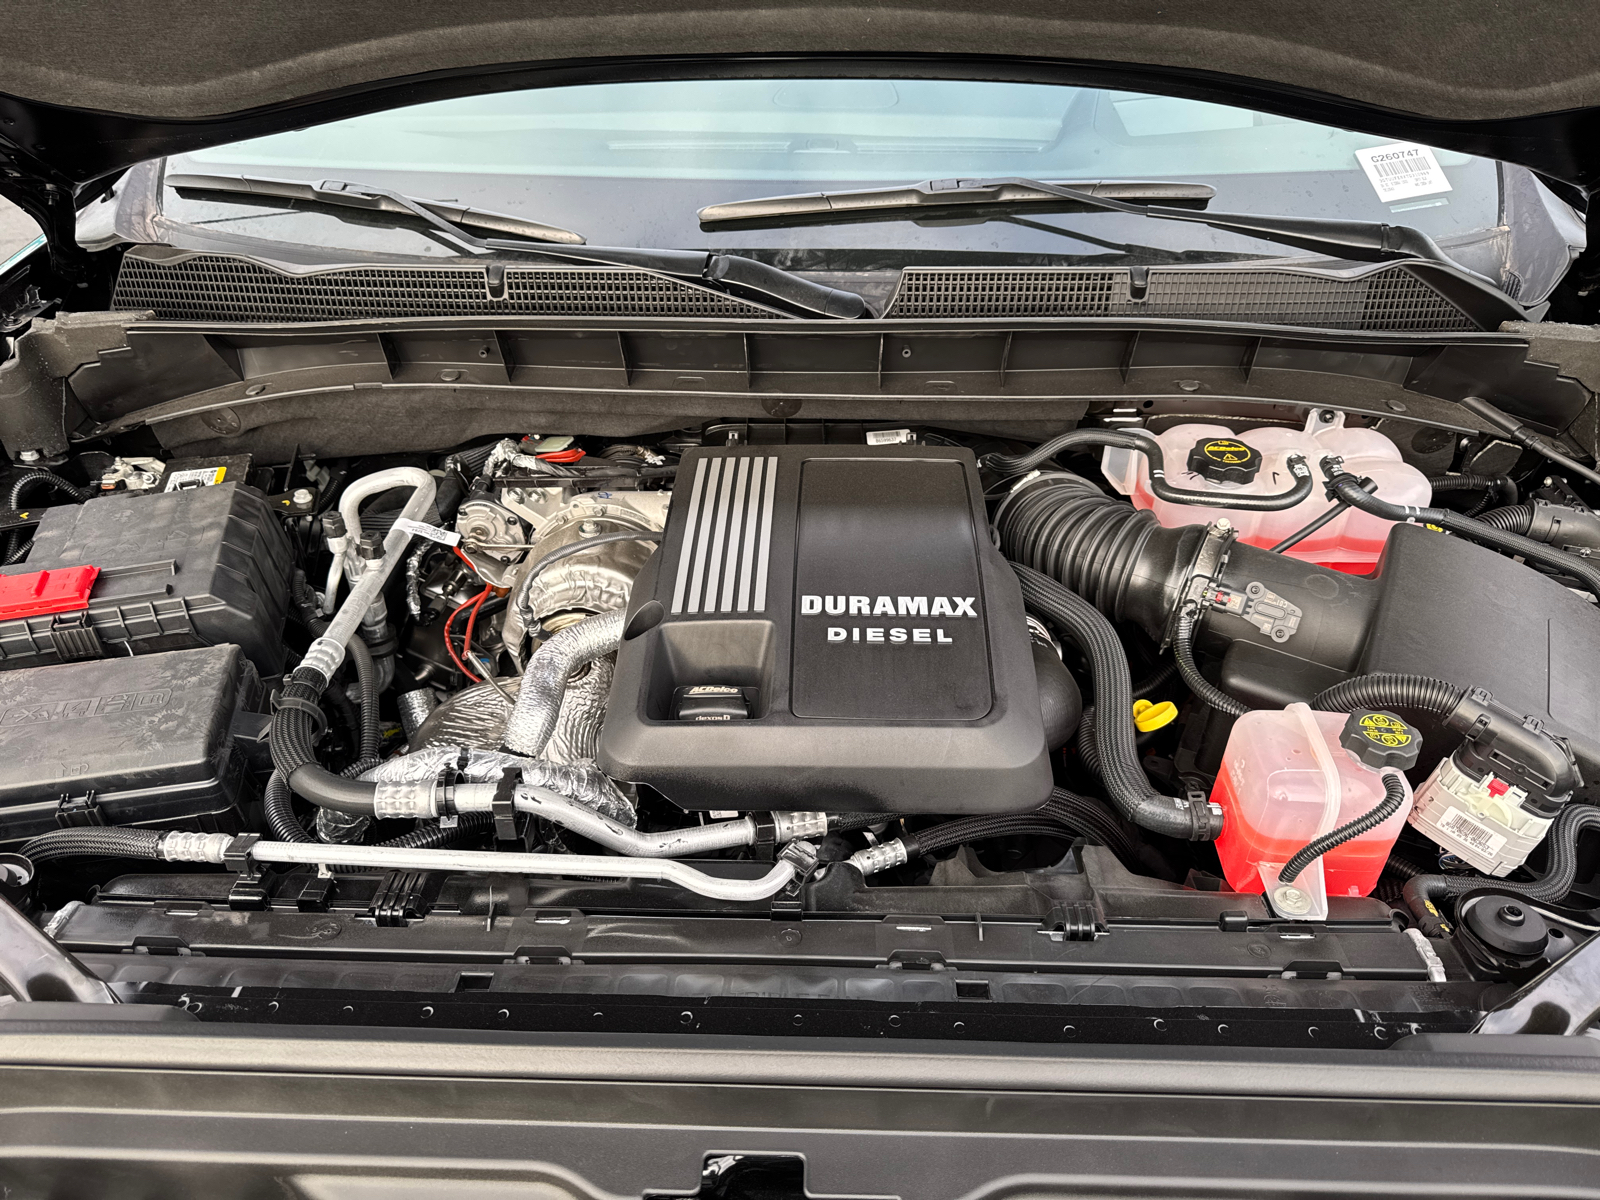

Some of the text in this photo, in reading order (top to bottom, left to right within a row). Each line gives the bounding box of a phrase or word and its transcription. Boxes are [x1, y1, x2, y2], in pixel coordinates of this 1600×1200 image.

[801, 595, 978, 617] DURAMAX
[827, 627, 953, 644] DIESEL
[688, 686, 739, 695] ACDelco
